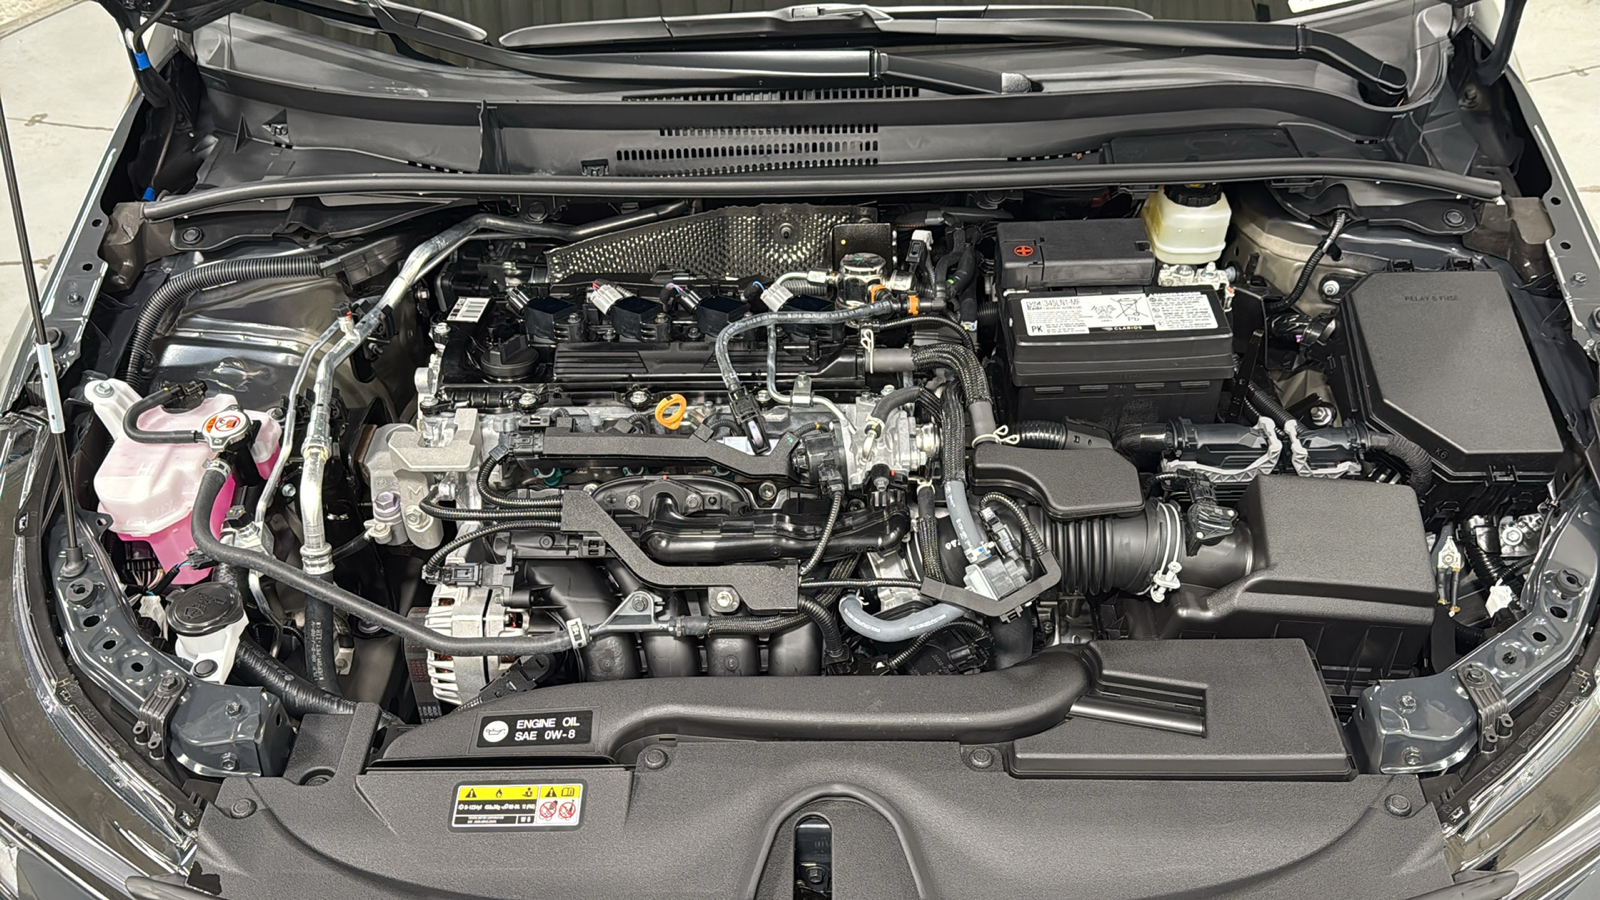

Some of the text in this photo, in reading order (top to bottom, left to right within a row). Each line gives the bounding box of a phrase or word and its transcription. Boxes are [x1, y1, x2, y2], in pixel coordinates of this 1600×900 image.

[1031, 325, 1044, 333] PK
[1434, 447, 1449, 460] K6
[516, 716, 580, 729] ENGINE OIL
[514, 729, 576, 741] SAE 0W-8
